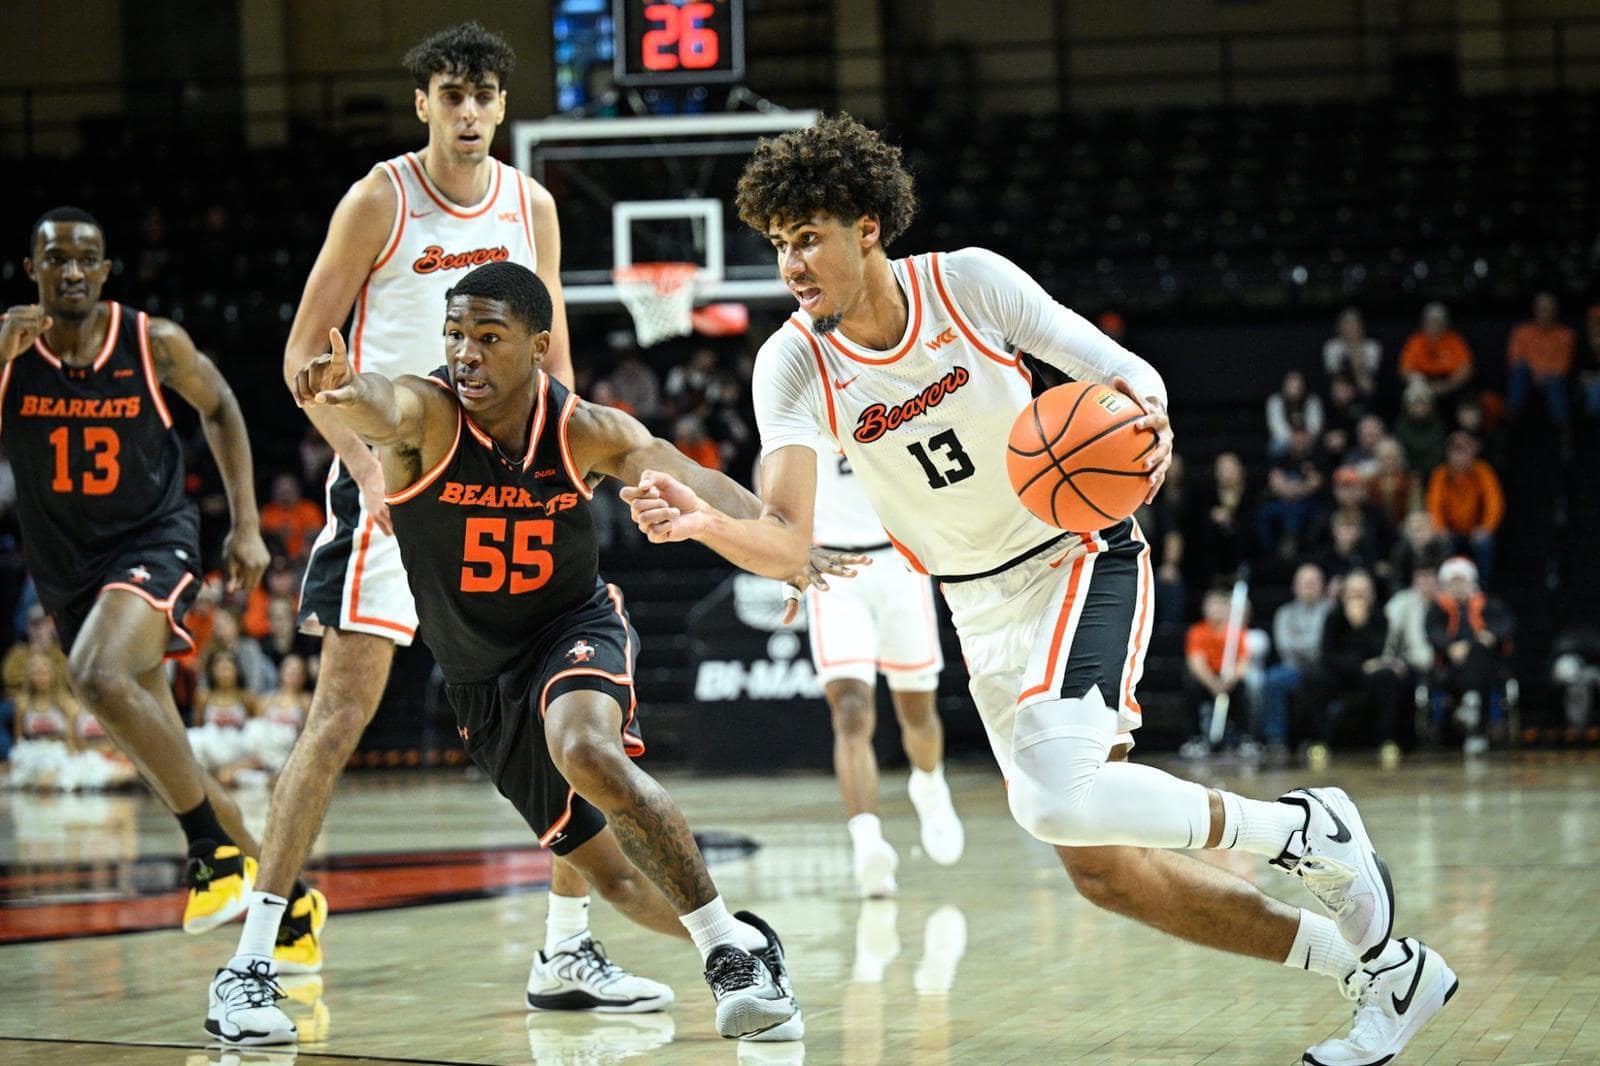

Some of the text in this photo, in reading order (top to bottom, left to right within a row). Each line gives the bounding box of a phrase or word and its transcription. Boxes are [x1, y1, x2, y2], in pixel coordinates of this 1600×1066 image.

[642, 3, 719, 71] 26
[413, 245, 510, 275] Beavers
[925, 326, 959, 351] WCC
[20, 395, 141, 418] BEARKATS
[853, 366, 970, 444] Beavers
[49, 426, 121, 496] 13
[906, 428, 976, 490] 13
[438, 481, 578, 517] BEARKTS
[460, 517, 555, 595] 55
[694, 659, 827, 702] BI-MA
